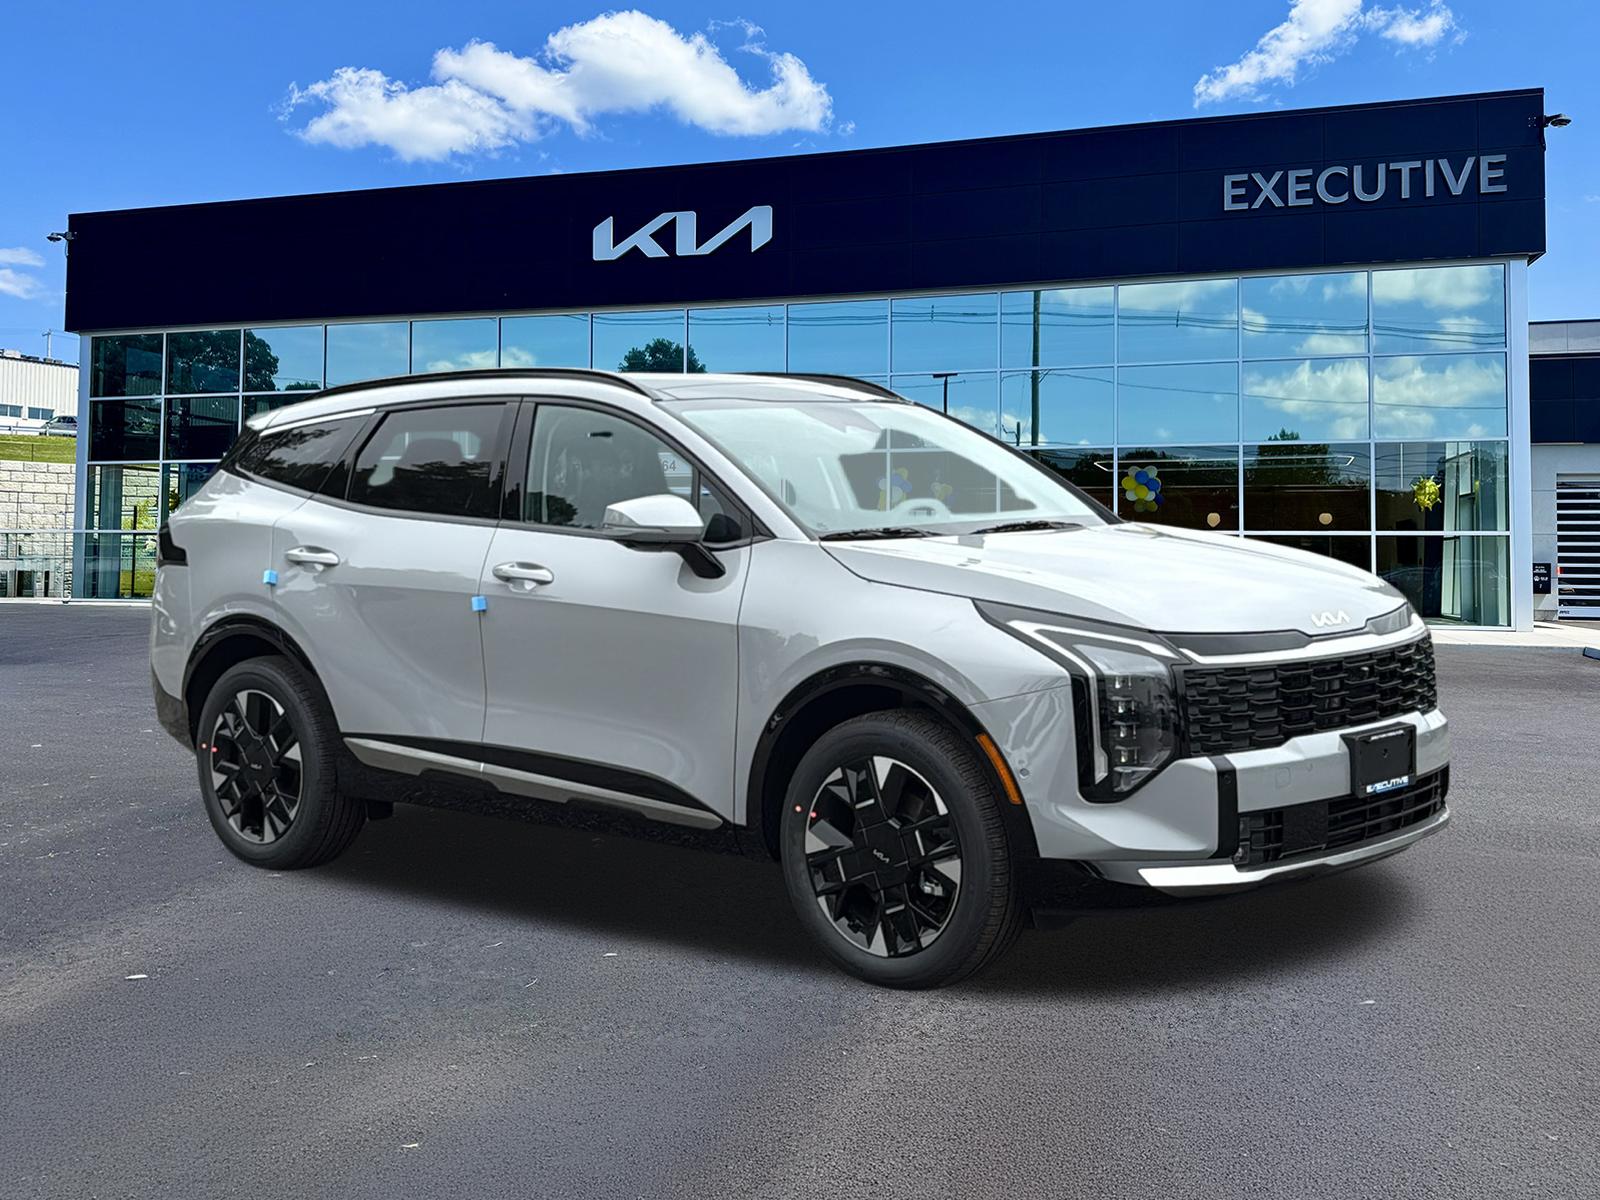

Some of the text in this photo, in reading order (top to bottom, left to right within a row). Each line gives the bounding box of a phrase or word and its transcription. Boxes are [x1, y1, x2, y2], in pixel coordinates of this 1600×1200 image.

[1223, 154, 1508, 212] EXECUTIVE
[592, 205, 773, 261] KIA
[1311, 609, 1350, 627] KIA
[1366, 775, 1409, 793] EXECUTIVE
